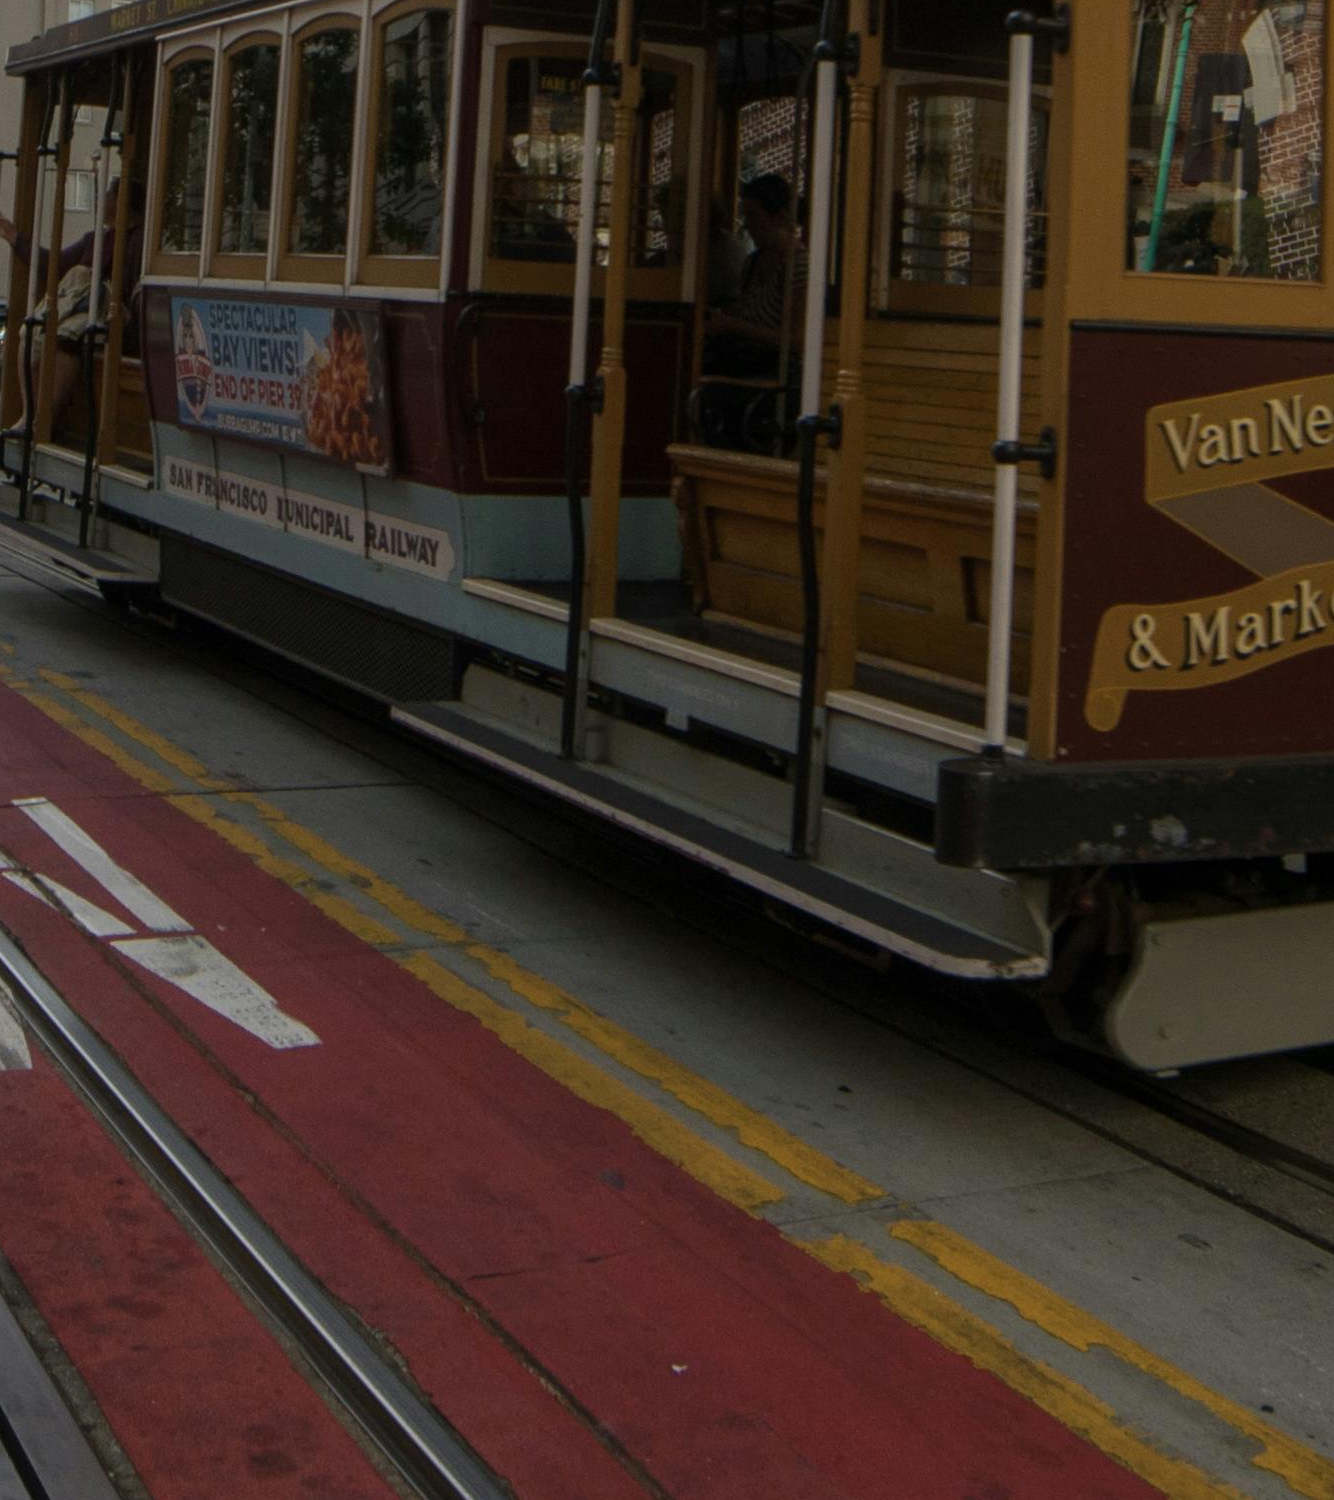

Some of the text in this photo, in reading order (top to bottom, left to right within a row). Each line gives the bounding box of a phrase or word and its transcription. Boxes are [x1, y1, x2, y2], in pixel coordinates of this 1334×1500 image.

[209, 303, 299, 335] SPECTACULAR
[211, 333, 300, 378] BAY VIEWS!
[214, 373, 302, 411] END OF PIER 39
[1160, 407, 1262, 473] Van
[168, 463, 440, 567] SAN FRANCISCO MUNICIPAL RAILWAY
[1126, 612, 1171, 674] &
